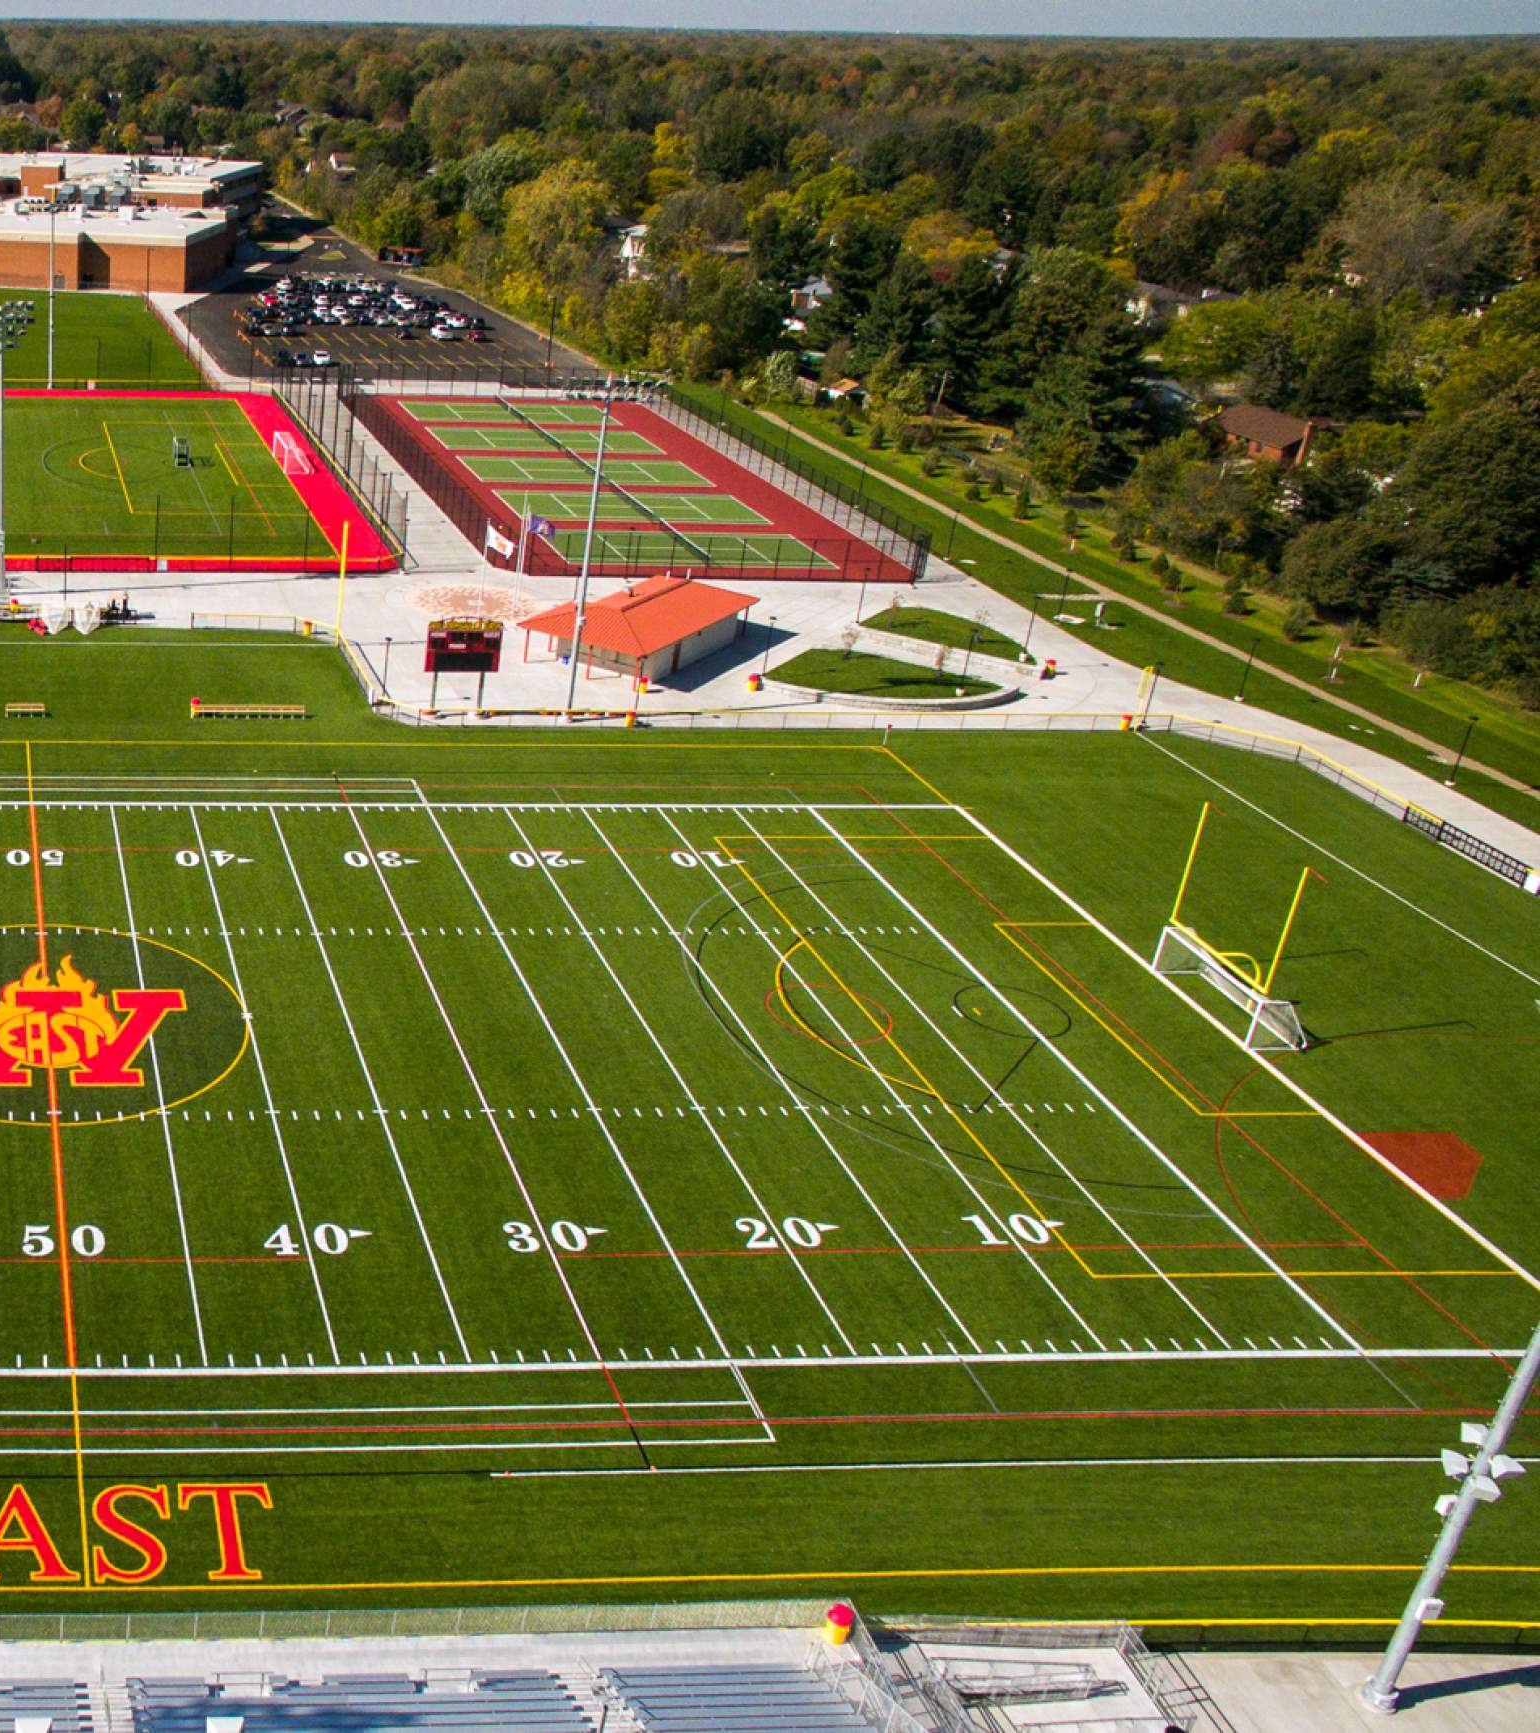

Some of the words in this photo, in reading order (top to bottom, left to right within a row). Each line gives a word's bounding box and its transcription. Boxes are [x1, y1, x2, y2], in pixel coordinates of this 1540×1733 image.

[6, 849, 64, 866] 50
[175, 850, 235, 867] 40
[344, 850, 402, 868] 30
[509, 851, 570, 868] 20
[670, 851, 731, 867] 10
[22, 1224, 105, 1257] 50
[263, 1222, 349, 1255] 40
[502, 1220, 588, 1253] 30
[735, 1216, 821, 1248] 20
[961, 1214, 1051, 1245] 10
